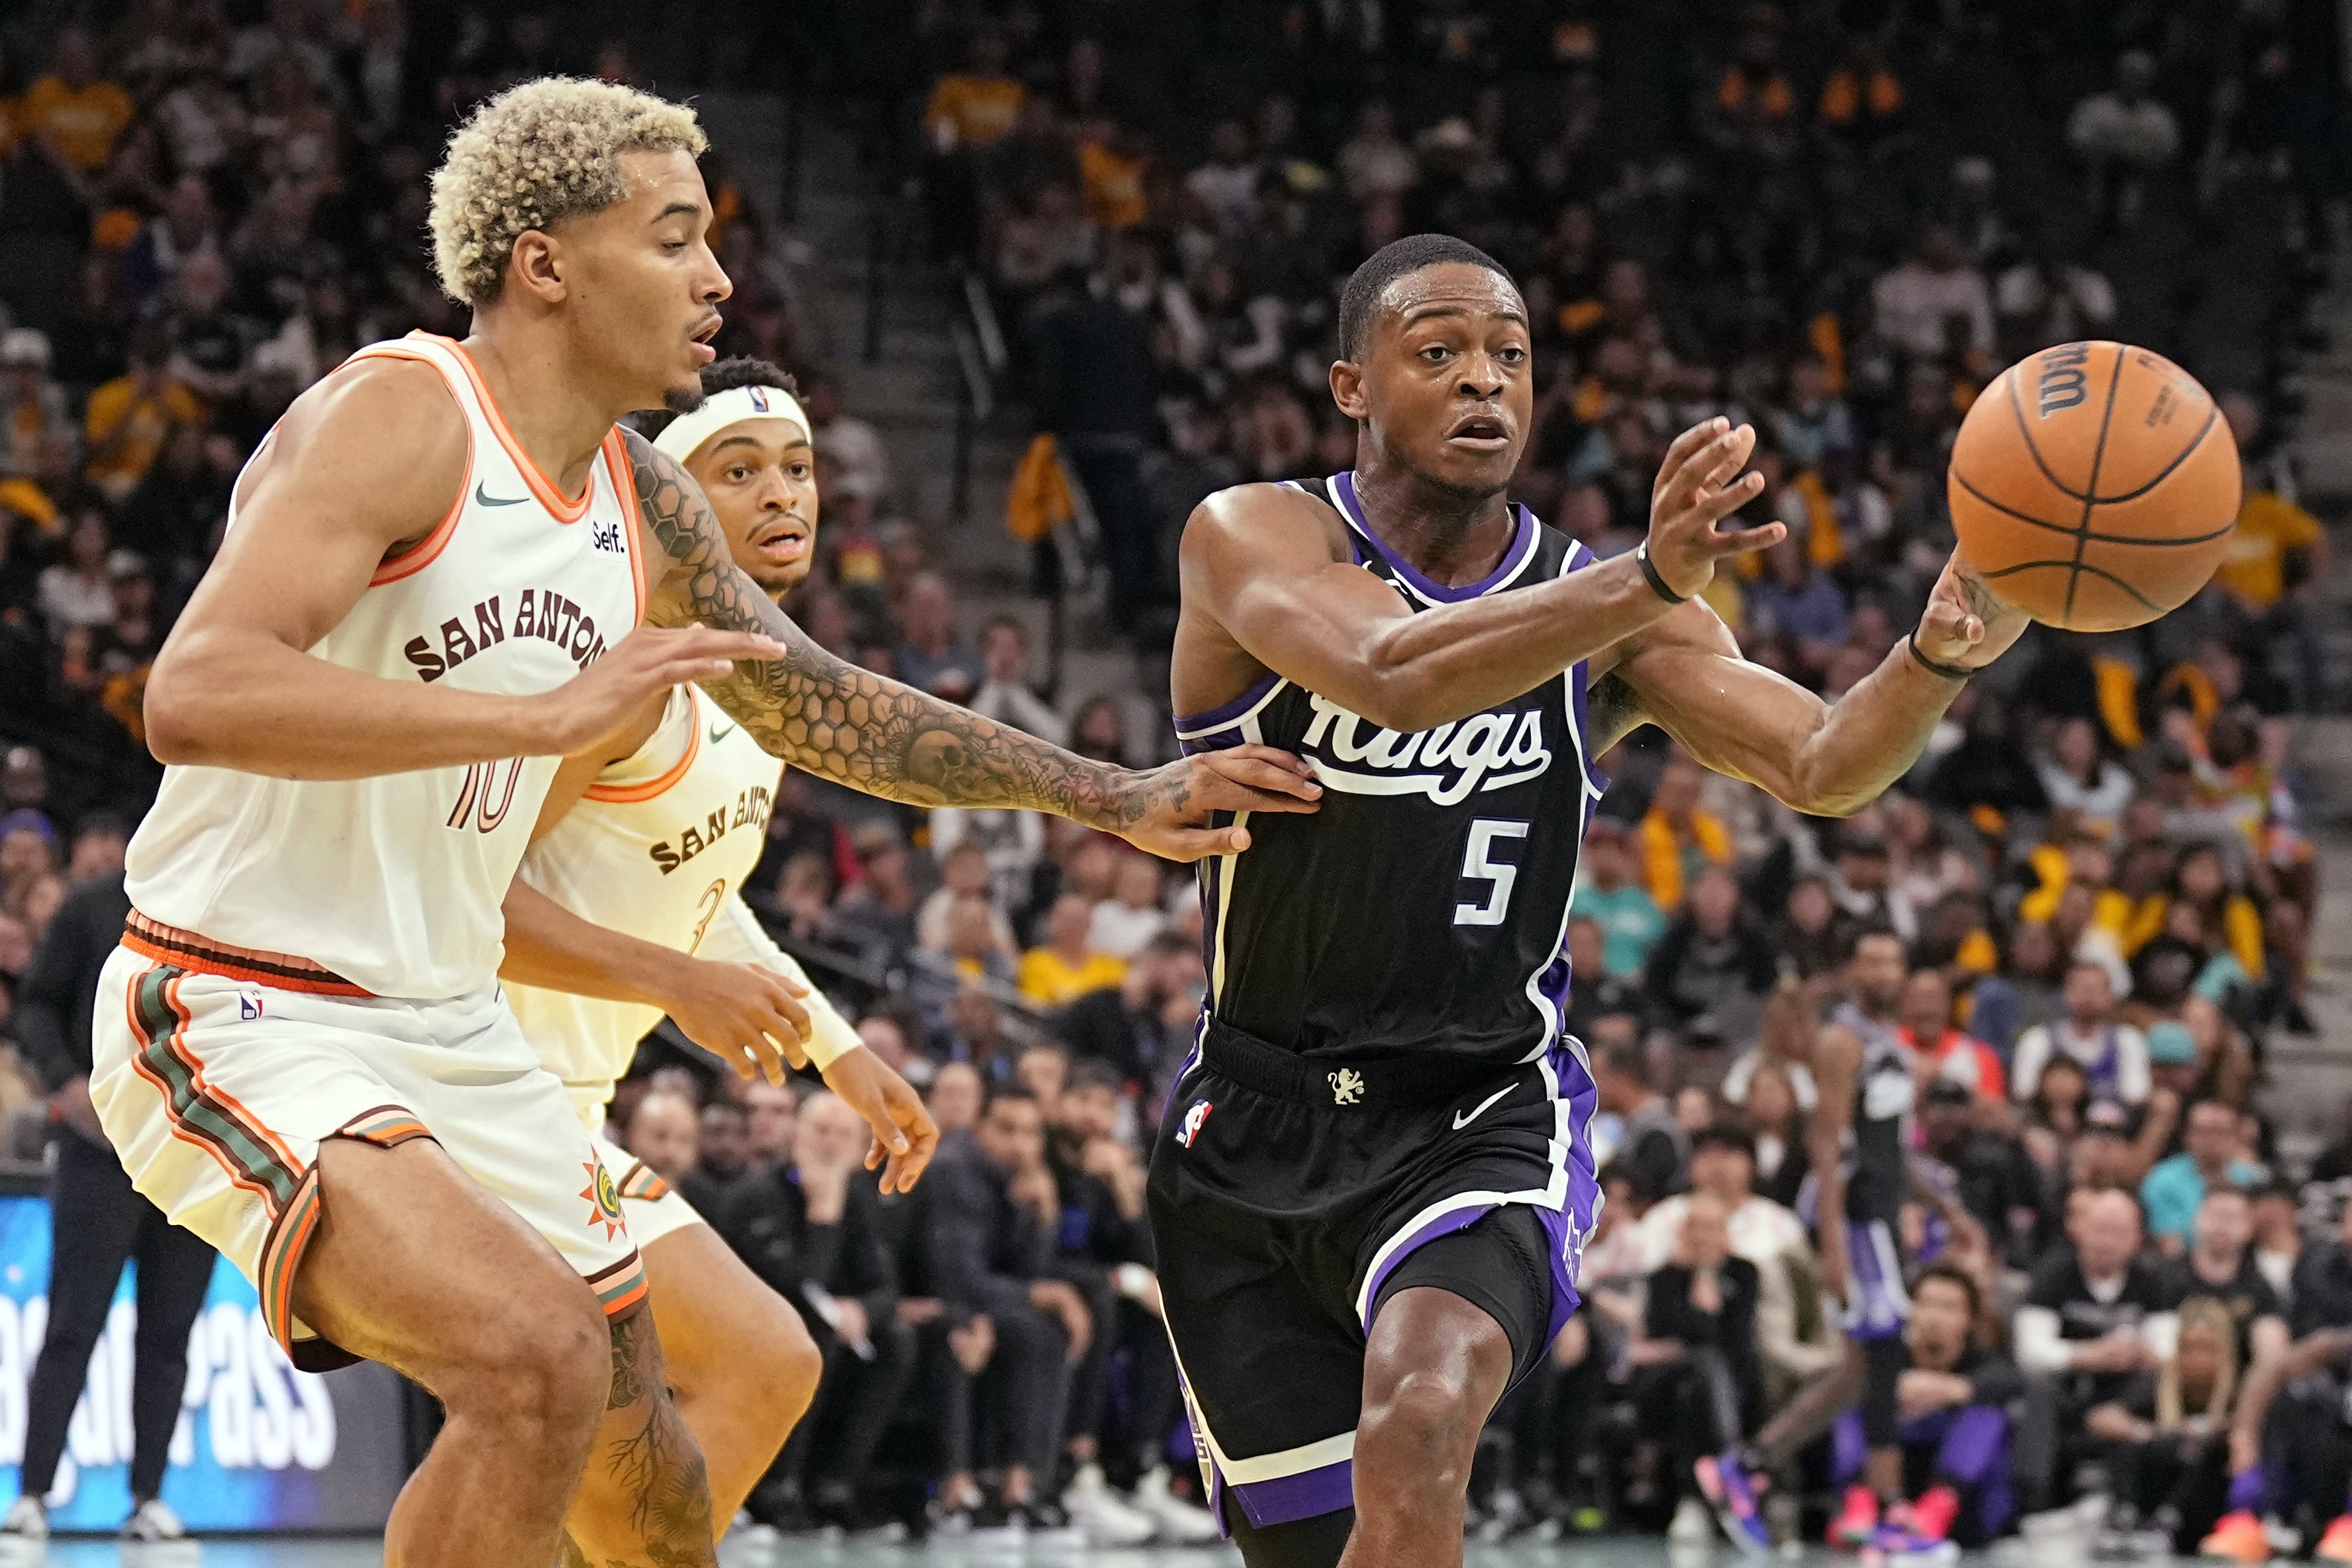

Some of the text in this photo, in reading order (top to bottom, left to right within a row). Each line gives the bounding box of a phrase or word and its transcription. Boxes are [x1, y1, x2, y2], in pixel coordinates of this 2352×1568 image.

[593, 520, 624, 552] Self.
[405, 595, 505, 683] SAN
[649, 786, 771, 876] SAN ANTO
[1453, 816, 1531, 926] 5
